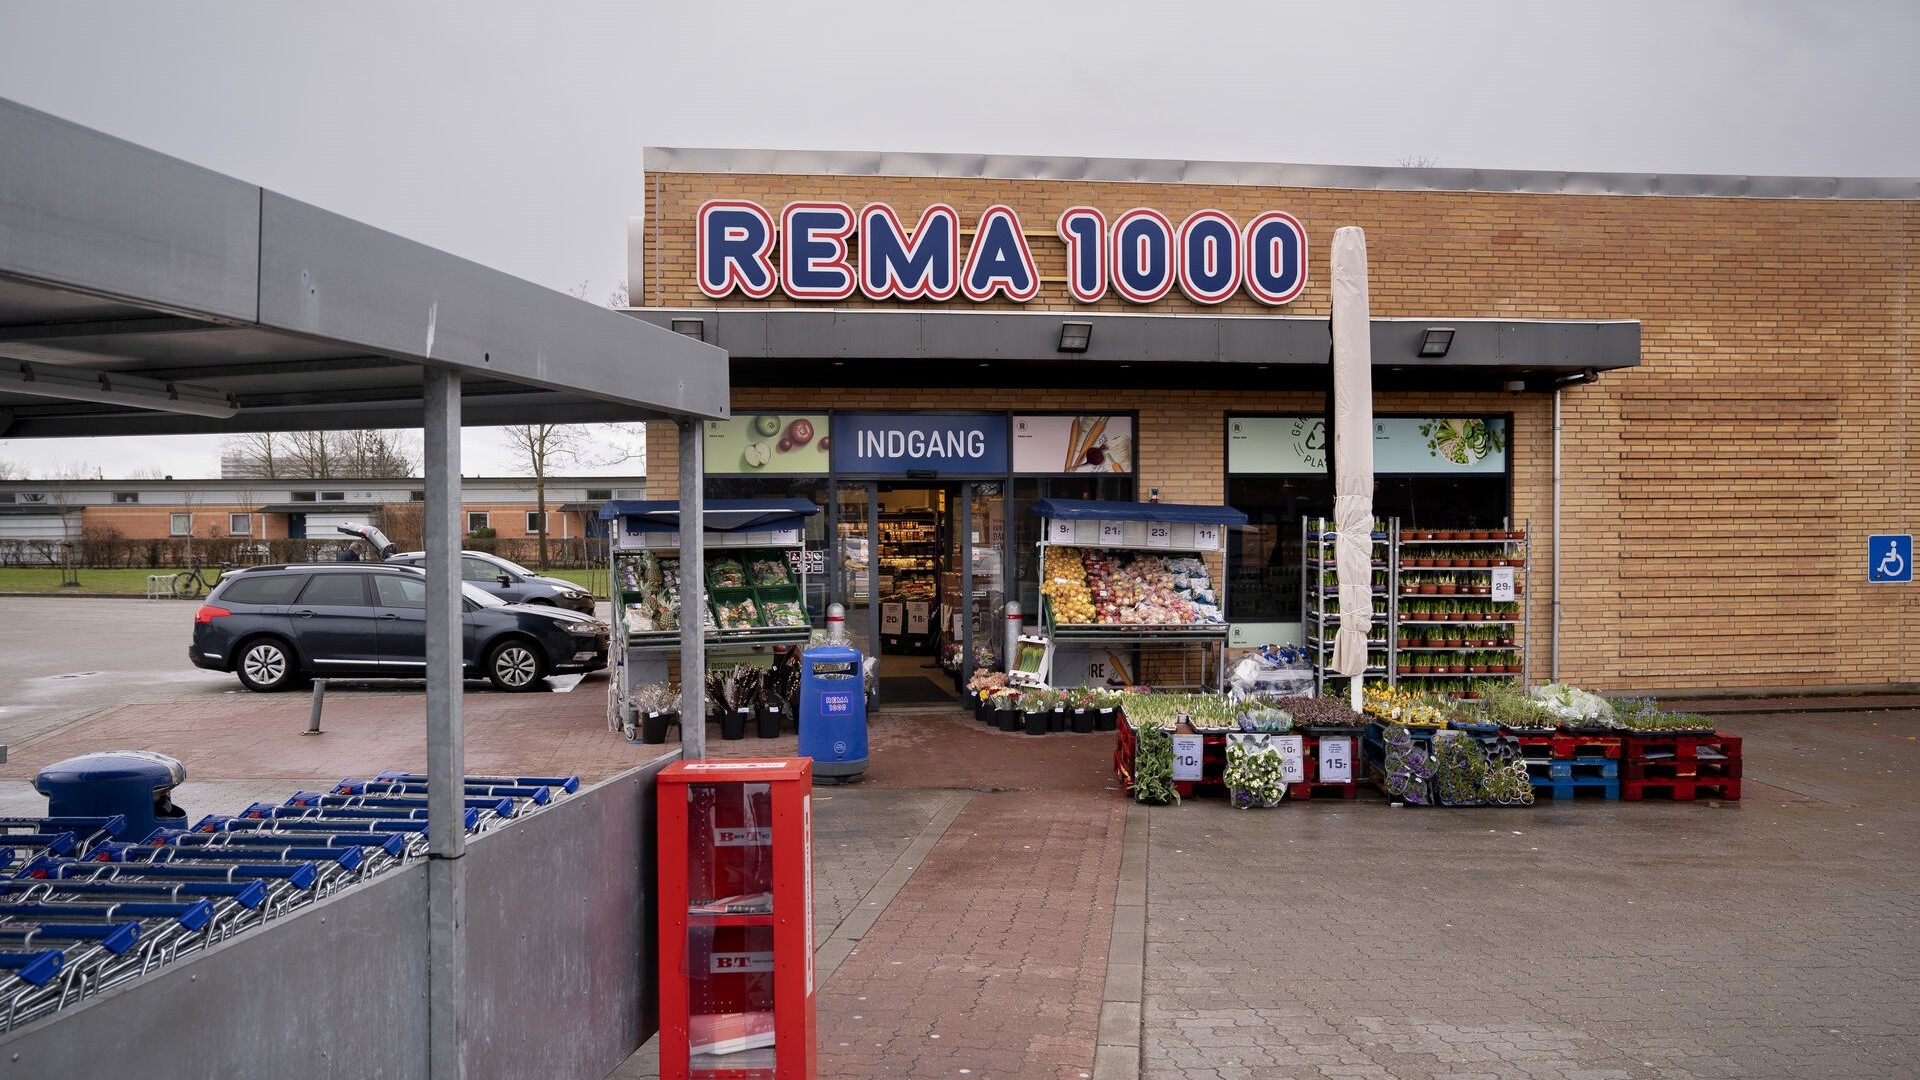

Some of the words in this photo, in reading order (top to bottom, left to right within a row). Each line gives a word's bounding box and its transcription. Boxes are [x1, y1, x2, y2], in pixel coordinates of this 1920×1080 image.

[697, 199, 1041, 304] REMA
[1056, 206, 1309, 306] 1000
[858, 430, 985, 458] INDGANG
[1088, 663, 1105, 678] RE
[825, 696, 849, 704] REMA
[828, 703, 847, 712] 1000
